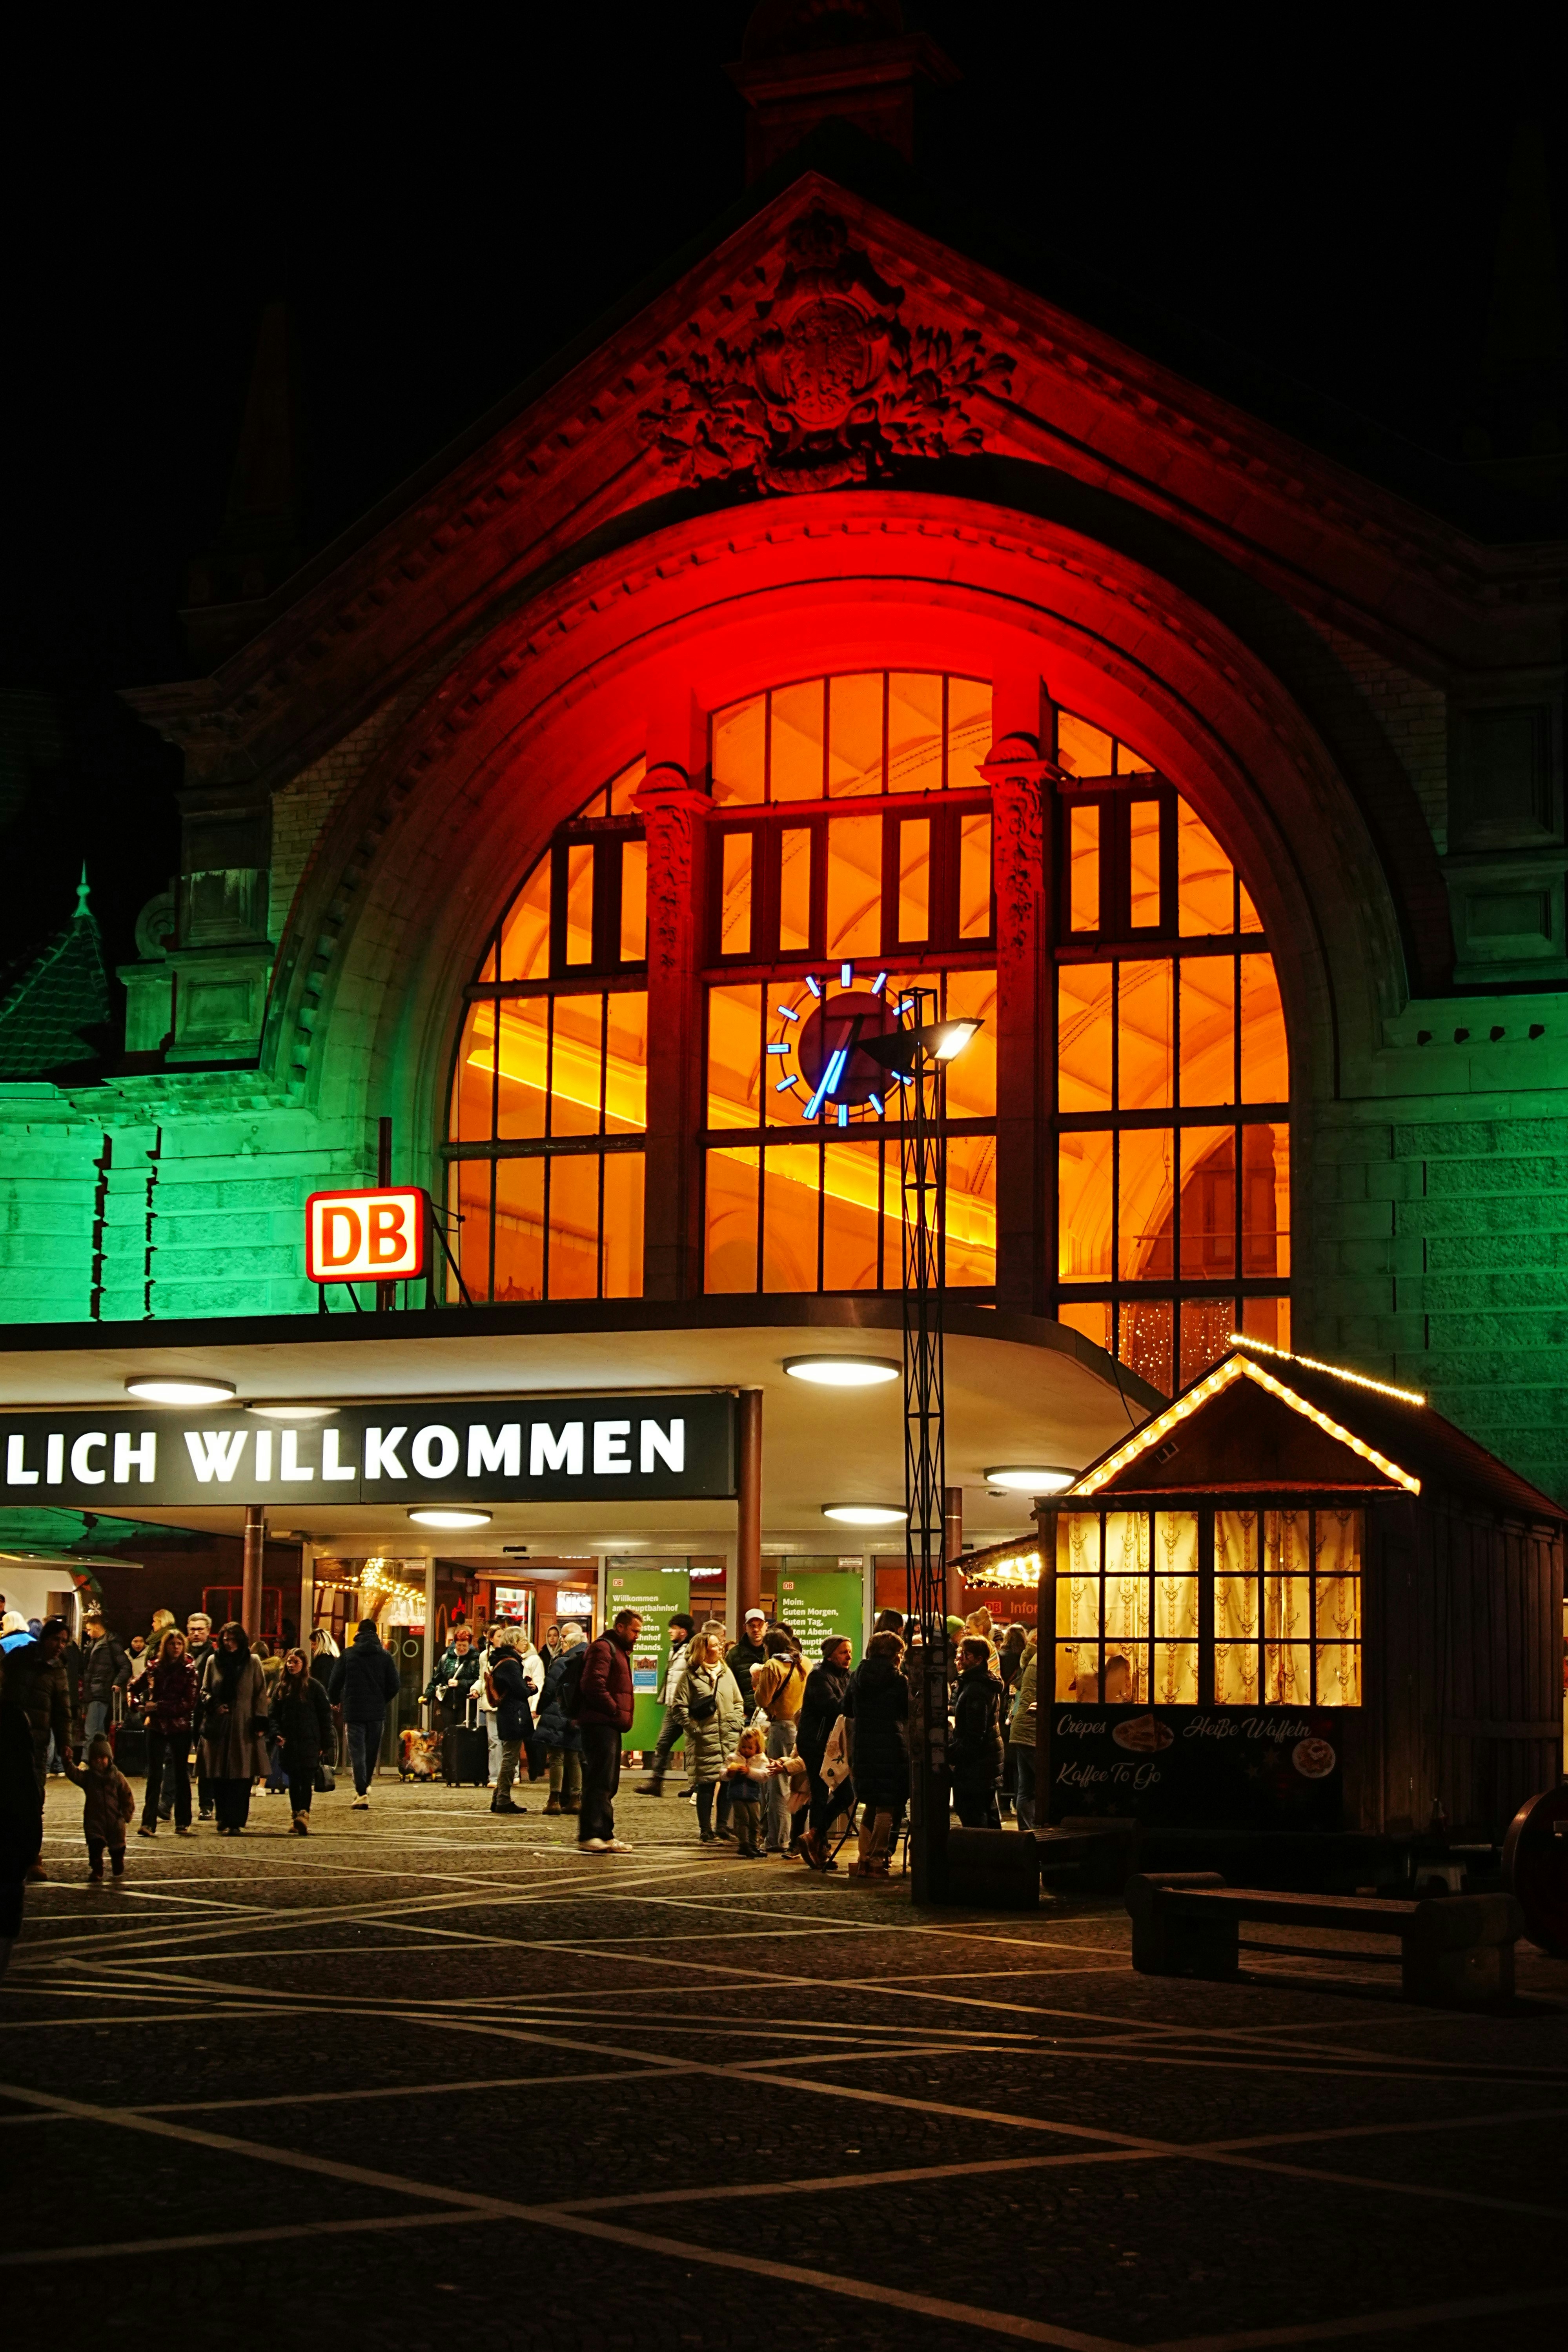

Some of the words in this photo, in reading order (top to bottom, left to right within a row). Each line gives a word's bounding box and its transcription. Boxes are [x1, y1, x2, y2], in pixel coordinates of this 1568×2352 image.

[322, 1204, 407, 1267] DB
[7, 1432, 156, 1485] LICH
[184, 1418, 685, 1483] WILLKOMMEN
[807, 1608, 839, 1617] Morgen,
[807, 1618, 823, 1626] Tag,
[1057, 1714, 1107, 1739] Crêpes
[1182, 1715, 1238, 1739] Heiße
[1240, 1718, 1311, 1743] Waffeln
[1056, 1762, 1109, 1788] Kaffee
[1111, 1763, 1135, 1784] To
[1133, 1764, 1162, 1790] Go
